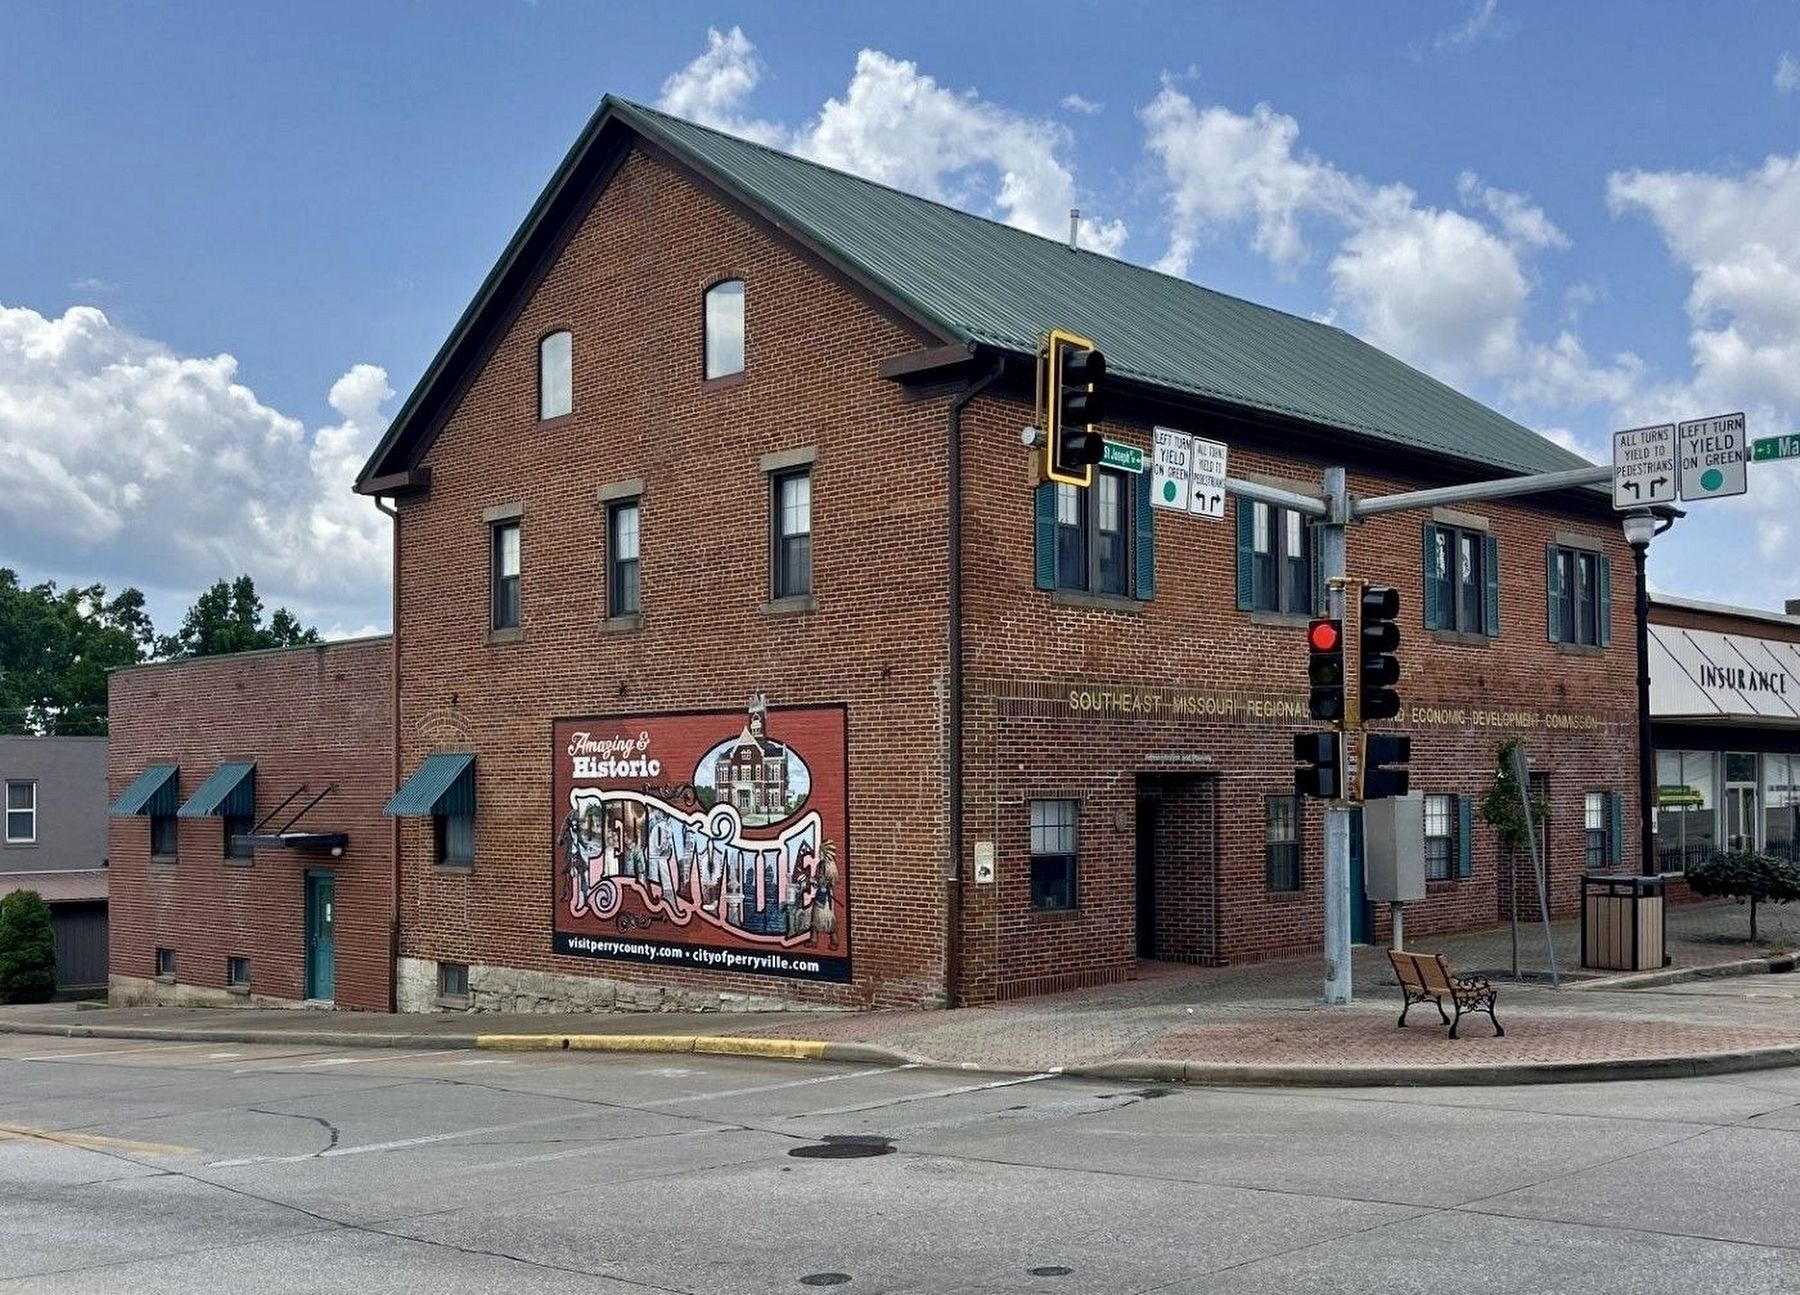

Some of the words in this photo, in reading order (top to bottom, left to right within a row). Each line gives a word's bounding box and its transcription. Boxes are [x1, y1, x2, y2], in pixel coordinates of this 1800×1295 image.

[1620, 434, 1637, 446] ALL
[1641, 429, 1669, 443] TURNS
[1680, 423, 1708, 438] LEFT
[1713, 418, 1742, 433] TURN
[1155, 432, 1170, 445] LEFT
[1175, 436, 1191, 450] TURN
[1690, 434, 1734, 453] YIELD
[1160, 447, 1185, 466] YIELD
[1625, 449, 1650, 461] YIELD
[1654, 445, 1666, 457] TO
[1682, 457, 1698, 470] ON
[1705, 451, 1743, 467] GREEN
[1153, 463, 1165, 476] ON
[1167, 466, 1189, 481] GREEN
[1617, 459, 1673, 477] PEDESTRIANS
[1700, 664, 1787, 694] INSURANCE
[1069, 690, 1161, 713] SOUTHEAST
[1173, 695, 1237, 716] MISSOURI
[1247, 699, 1310, 718] REGIONAL
[1412, 707, 1466, 725] ECONOMIC
[1472, 710, 1539, 728] DEVELOPMENT
[1545, 712, 1598, 729] COMMISSION
[567, 731, 635, 760] Amazing
[636, 731, 650, 751] &
[572, 754, 661, 778] Historic
[568, 937, 683, 960] visitperrycounty.com
[692, 948, 820, 972] cityofperryville.com
